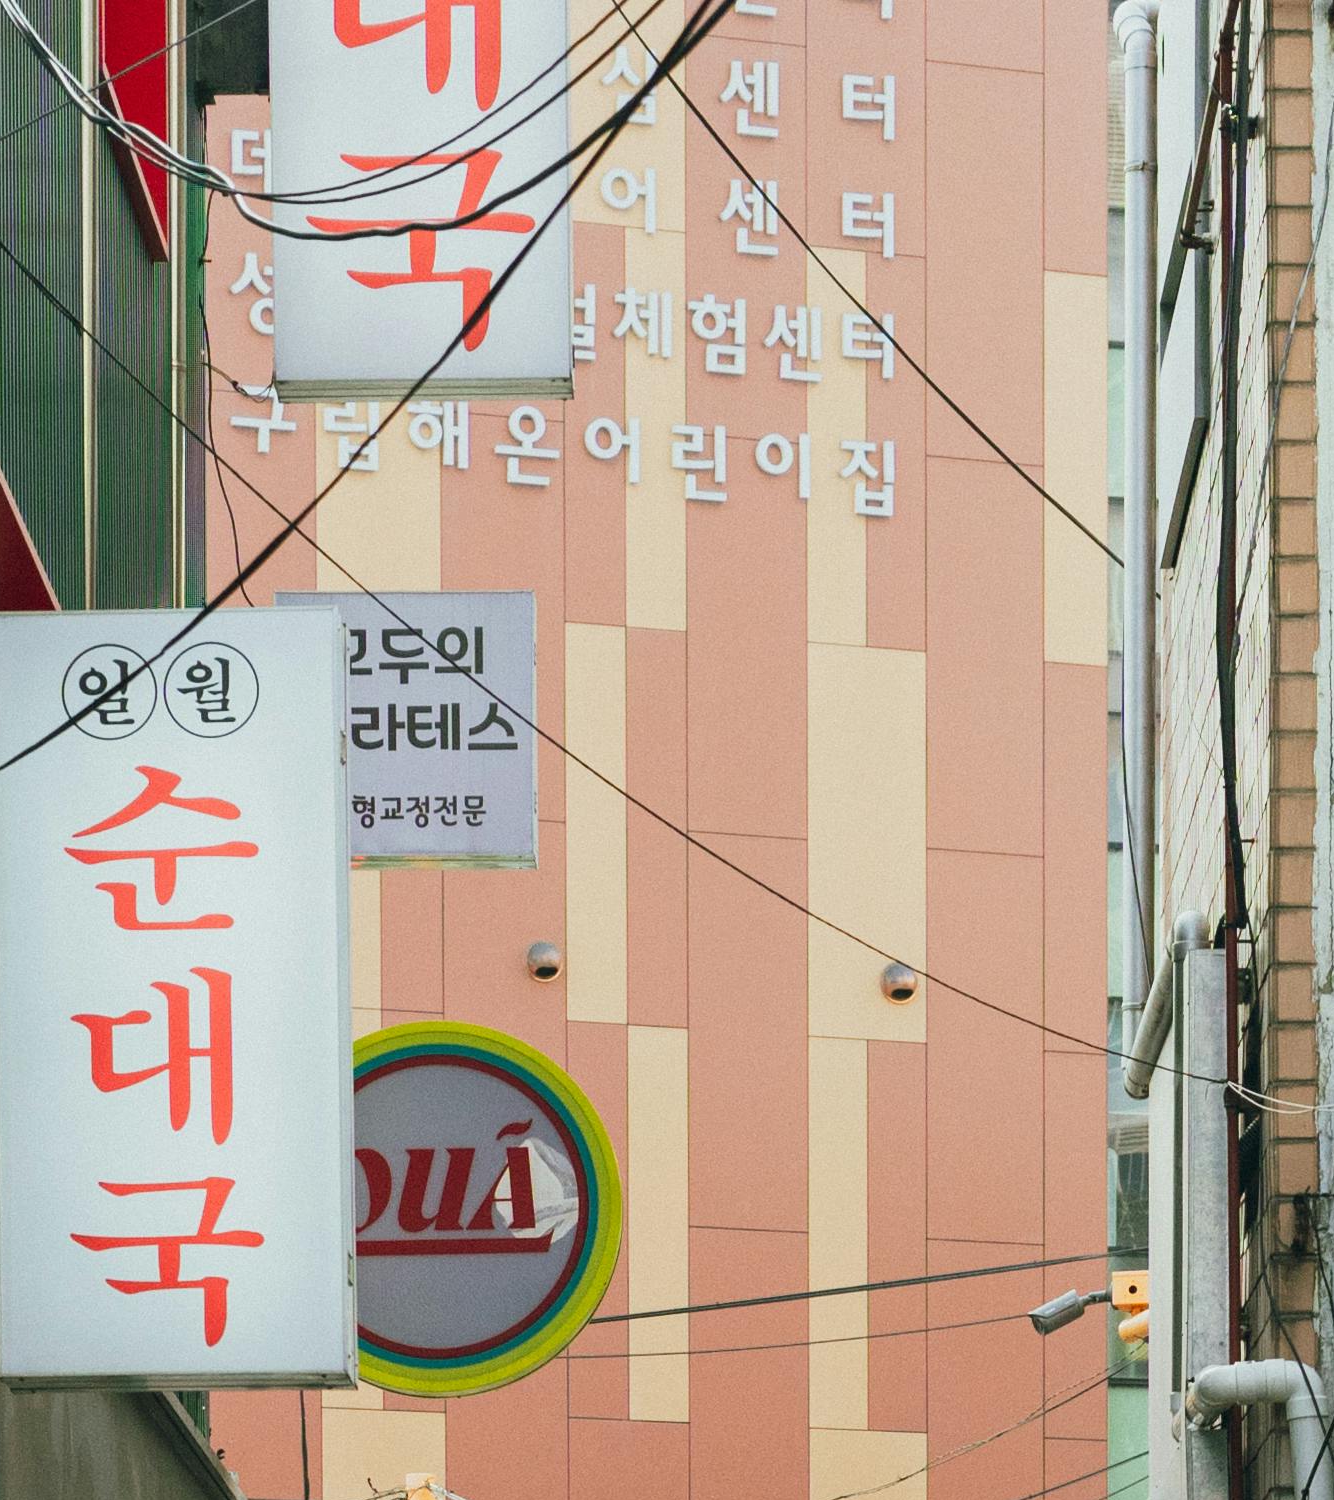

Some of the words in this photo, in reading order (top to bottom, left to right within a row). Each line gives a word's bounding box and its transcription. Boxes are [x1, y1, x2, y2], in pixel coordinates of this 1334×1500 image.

[602, 47, 895, 141] 심센터
[351, 703, 518, 751] 라테스
[351, 795, 486, 829] 형교정전문
[64, 765, 264, 1348] 순대국
